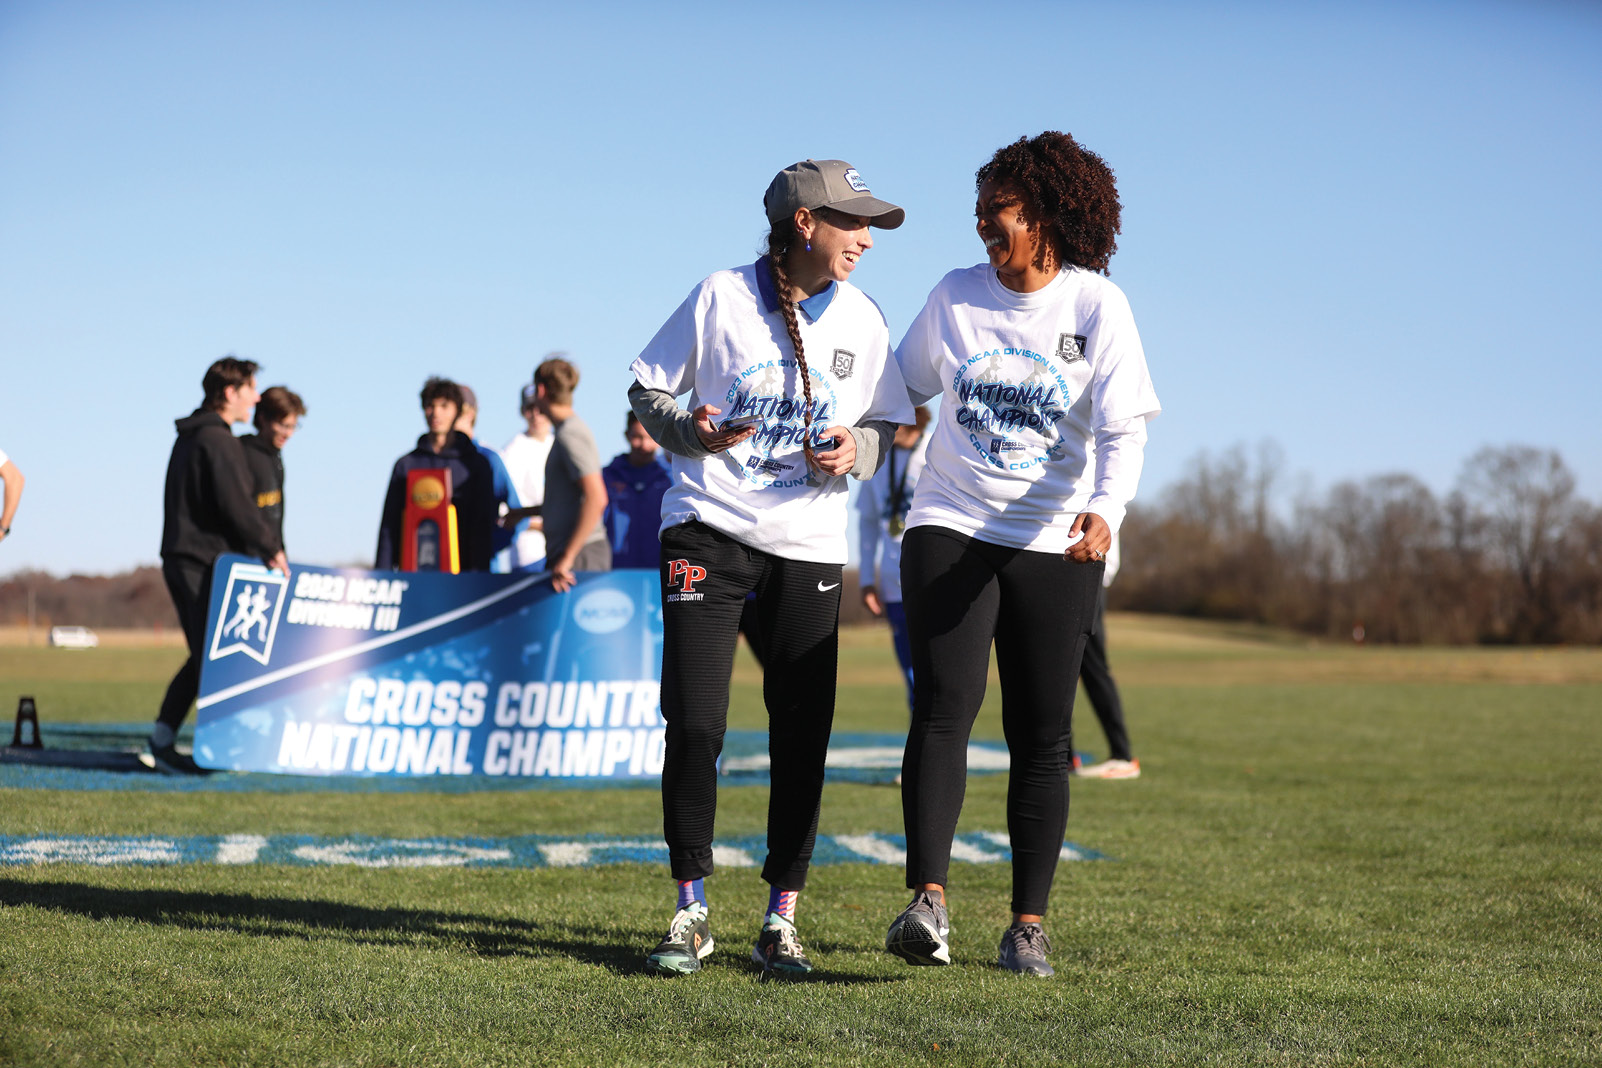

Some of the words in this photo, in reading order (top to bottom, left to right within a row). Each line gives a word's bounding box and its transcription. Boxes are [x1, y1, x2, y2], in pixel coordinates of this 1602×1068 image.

[837, 356, 850, 370] 50
[1064, 340, 1080, 353] 50
[726, 377, 742, 404] 2023
[741, 360, 775, 379] NCAA
[953, 364, 968, 392] 2023
[967, 349, 1000, 366] NCAA
[1004, 347, 1049, 367] DIVISION
[1048, 365, 1058, 375] III
[727, 390, 832, 423] NATIONAL
[958, 379, 1060, 407] NATIONAL
[969, 433, 1005, 469] CROSS
[763, 470, 819, 488] COUNT
[294, 572, 346, 602] 2023
[667, 559, 707, 592] PP
[680, 593, 705, 601] COUNTRY
[286, 598, 375, 631] DIVISION
[374, 606, 401, 631] III
[344, 678, 488, 727] CROSS
[494, 680, 667, 728] COUNTR
[277, 720, 473, 775] NATIONAL
